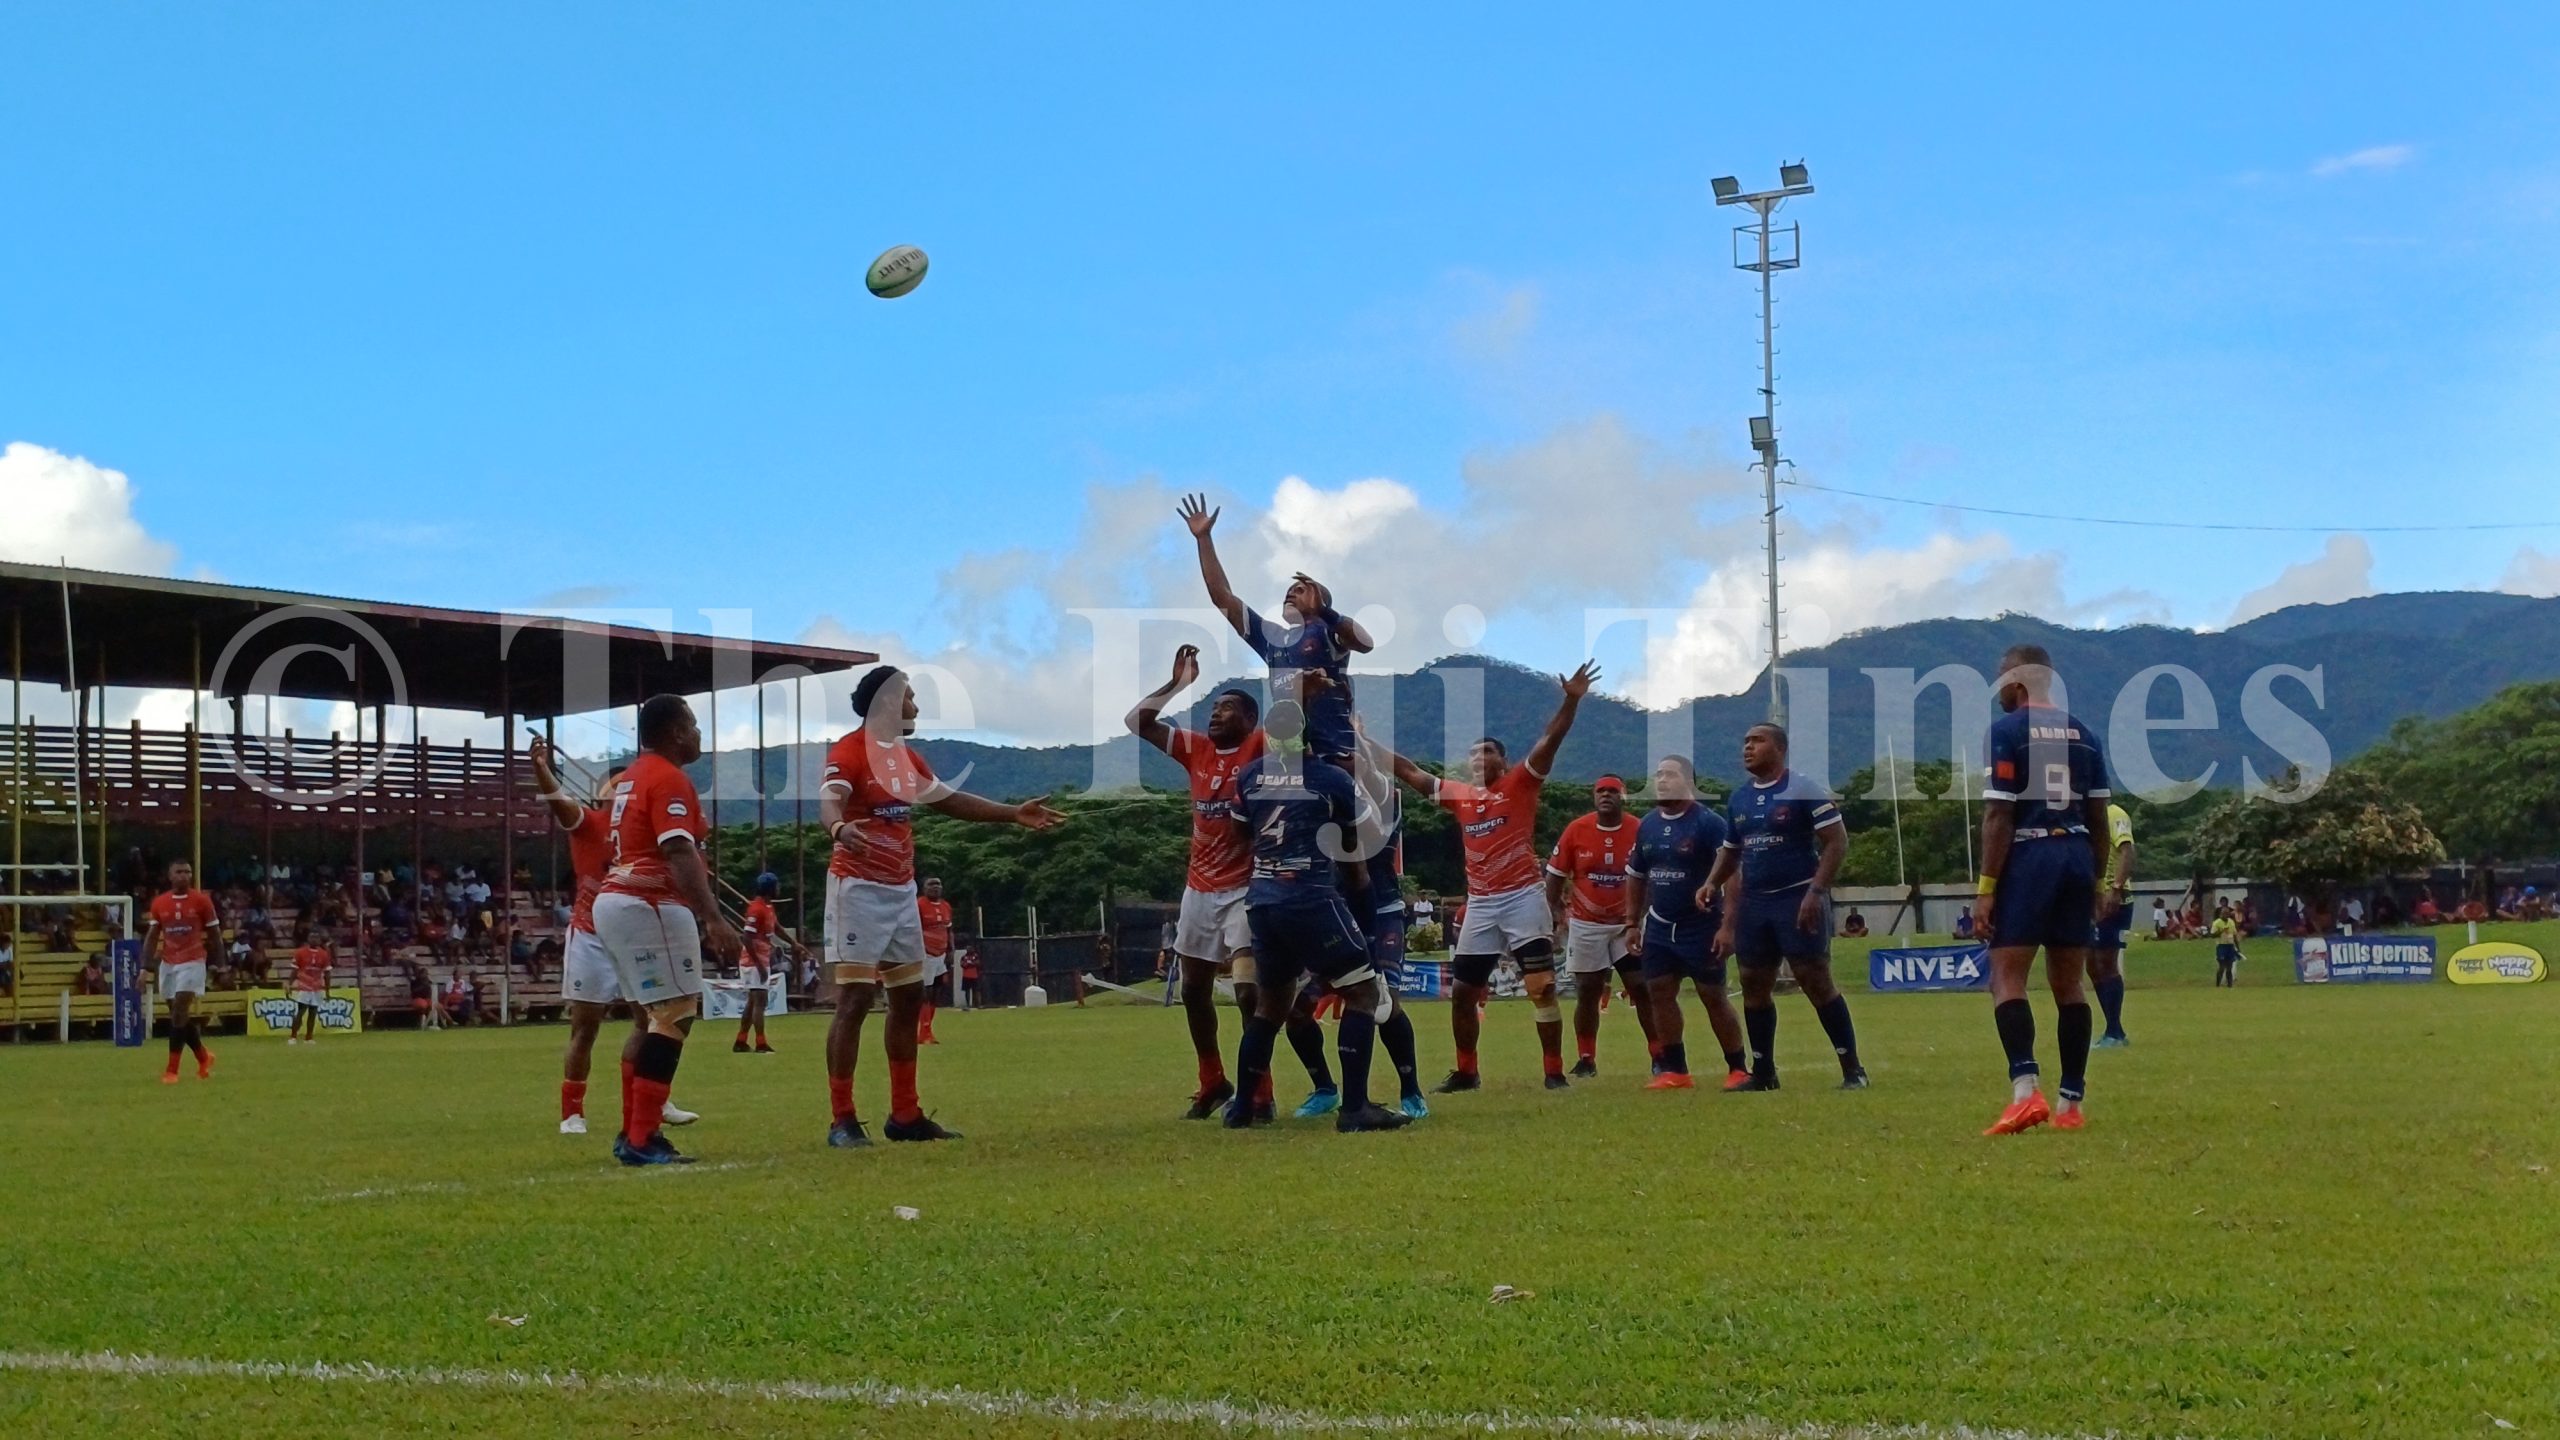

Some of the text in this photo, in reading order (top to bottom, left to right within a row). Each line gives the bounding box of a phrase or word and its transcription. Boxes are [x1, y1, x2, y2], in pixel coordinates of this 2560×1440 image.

[2045, 764, 2071, 811] 9
[1196, 800, 1231, 811] SKIPPE
[1259, 805, 1286, 845] 4
[1464, 818, 1505, 833] SKIPPER
[1744, 835, 1784, 846] SKIPPER
[1649, 869, 1686, 879] SKIPPER
[2331, 943, 2370, 965] Kills
[2372, 944, 2433, 965] germs.
[1883, 954, 1980, 983] NIVEA
[2488, 956, 2535, 970] Nappy
[2499, 967, 2533, 978] Time
[266, 1014, 295, 1029] Tim
[318, 1013, 354, 1029] Time
